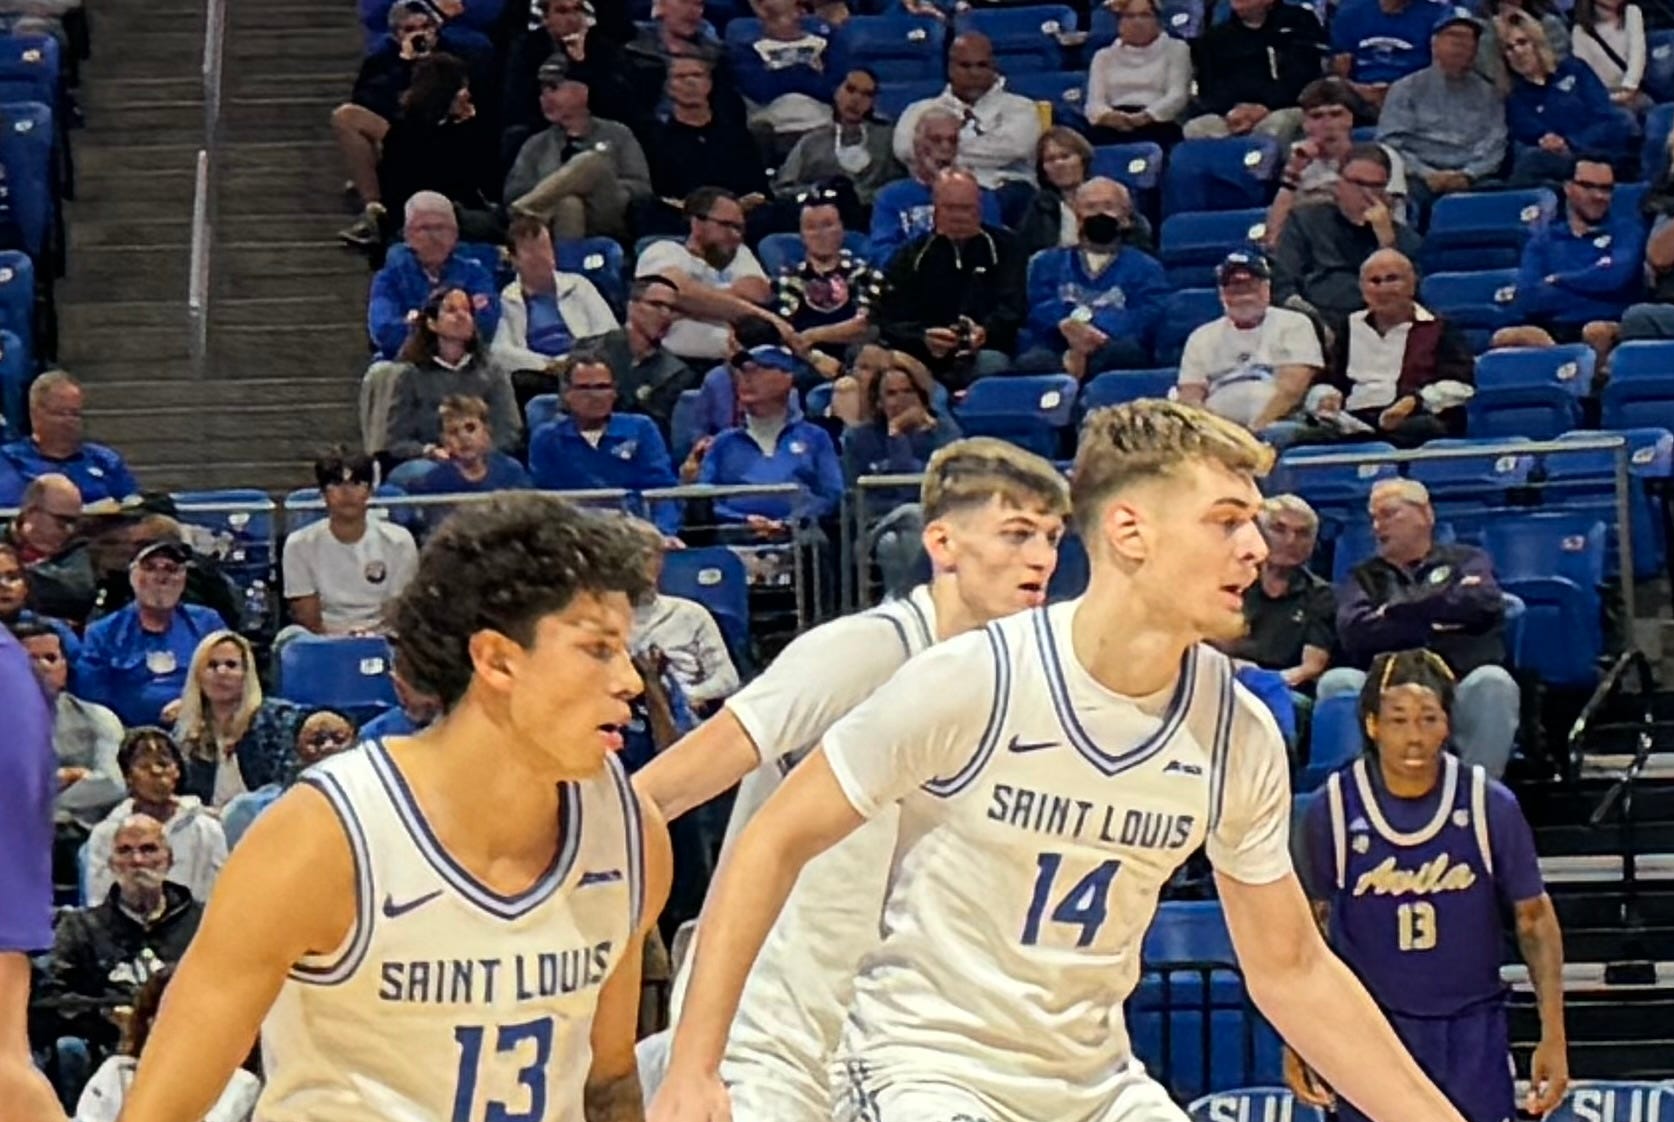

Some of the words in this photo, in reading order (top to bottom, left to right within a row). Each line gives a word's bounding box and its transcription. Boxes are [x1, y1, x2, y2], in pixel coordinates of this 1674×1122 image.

[987, 784, 1093, 838] SAINT
[1100, 805, 1195, 849] LOUIS
[1020, 852, 1123, 947] 14
[1352, 852, 1477, 897] Avila
[1397, 901, 1437, 951] 13
[378, 959, 500, 1004] SAINT
[515, 940, 613, 1001] LOUIS
